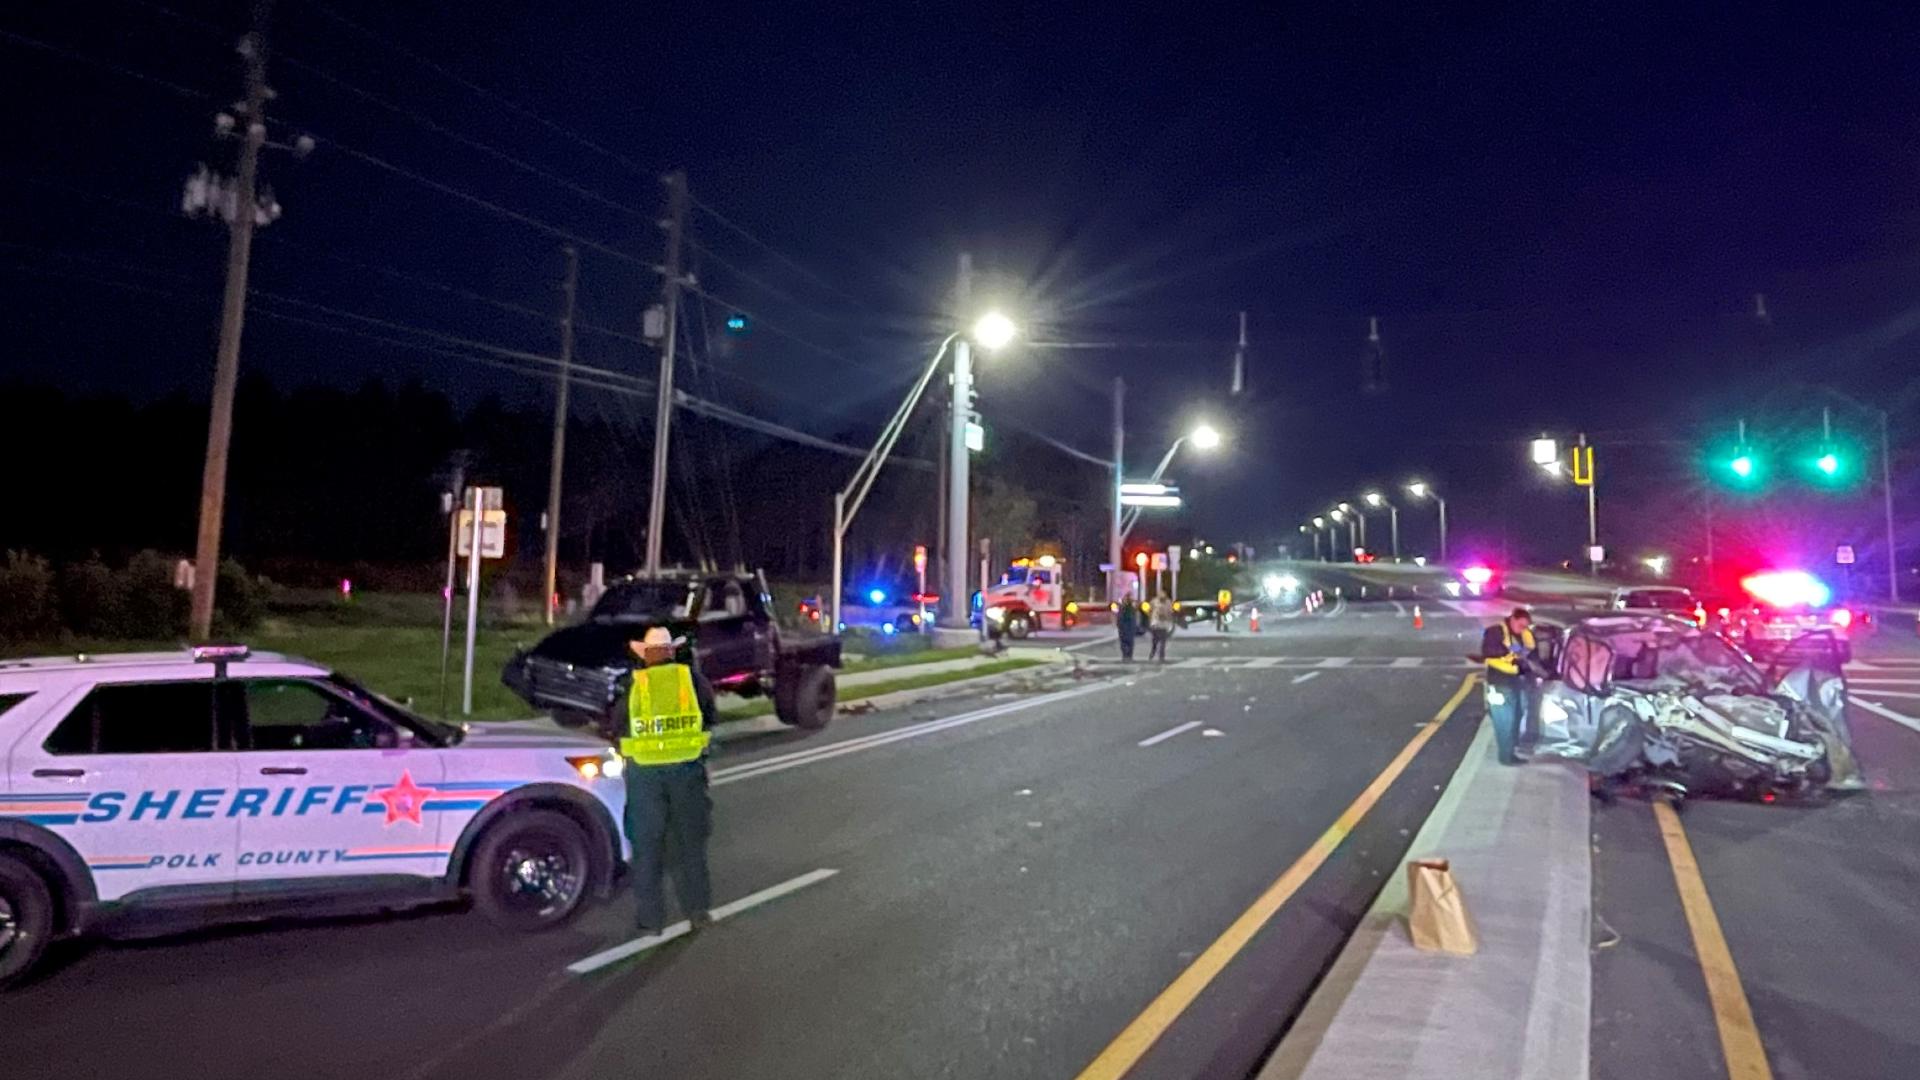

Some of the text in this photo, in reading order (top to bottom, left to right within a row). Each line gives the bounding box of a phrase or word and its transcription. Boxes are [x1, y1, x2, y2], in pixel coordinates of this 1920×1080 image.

[81, 785, 369, 823] SHERIFF
[148, 849, 349, 868] POLK COUNTY
